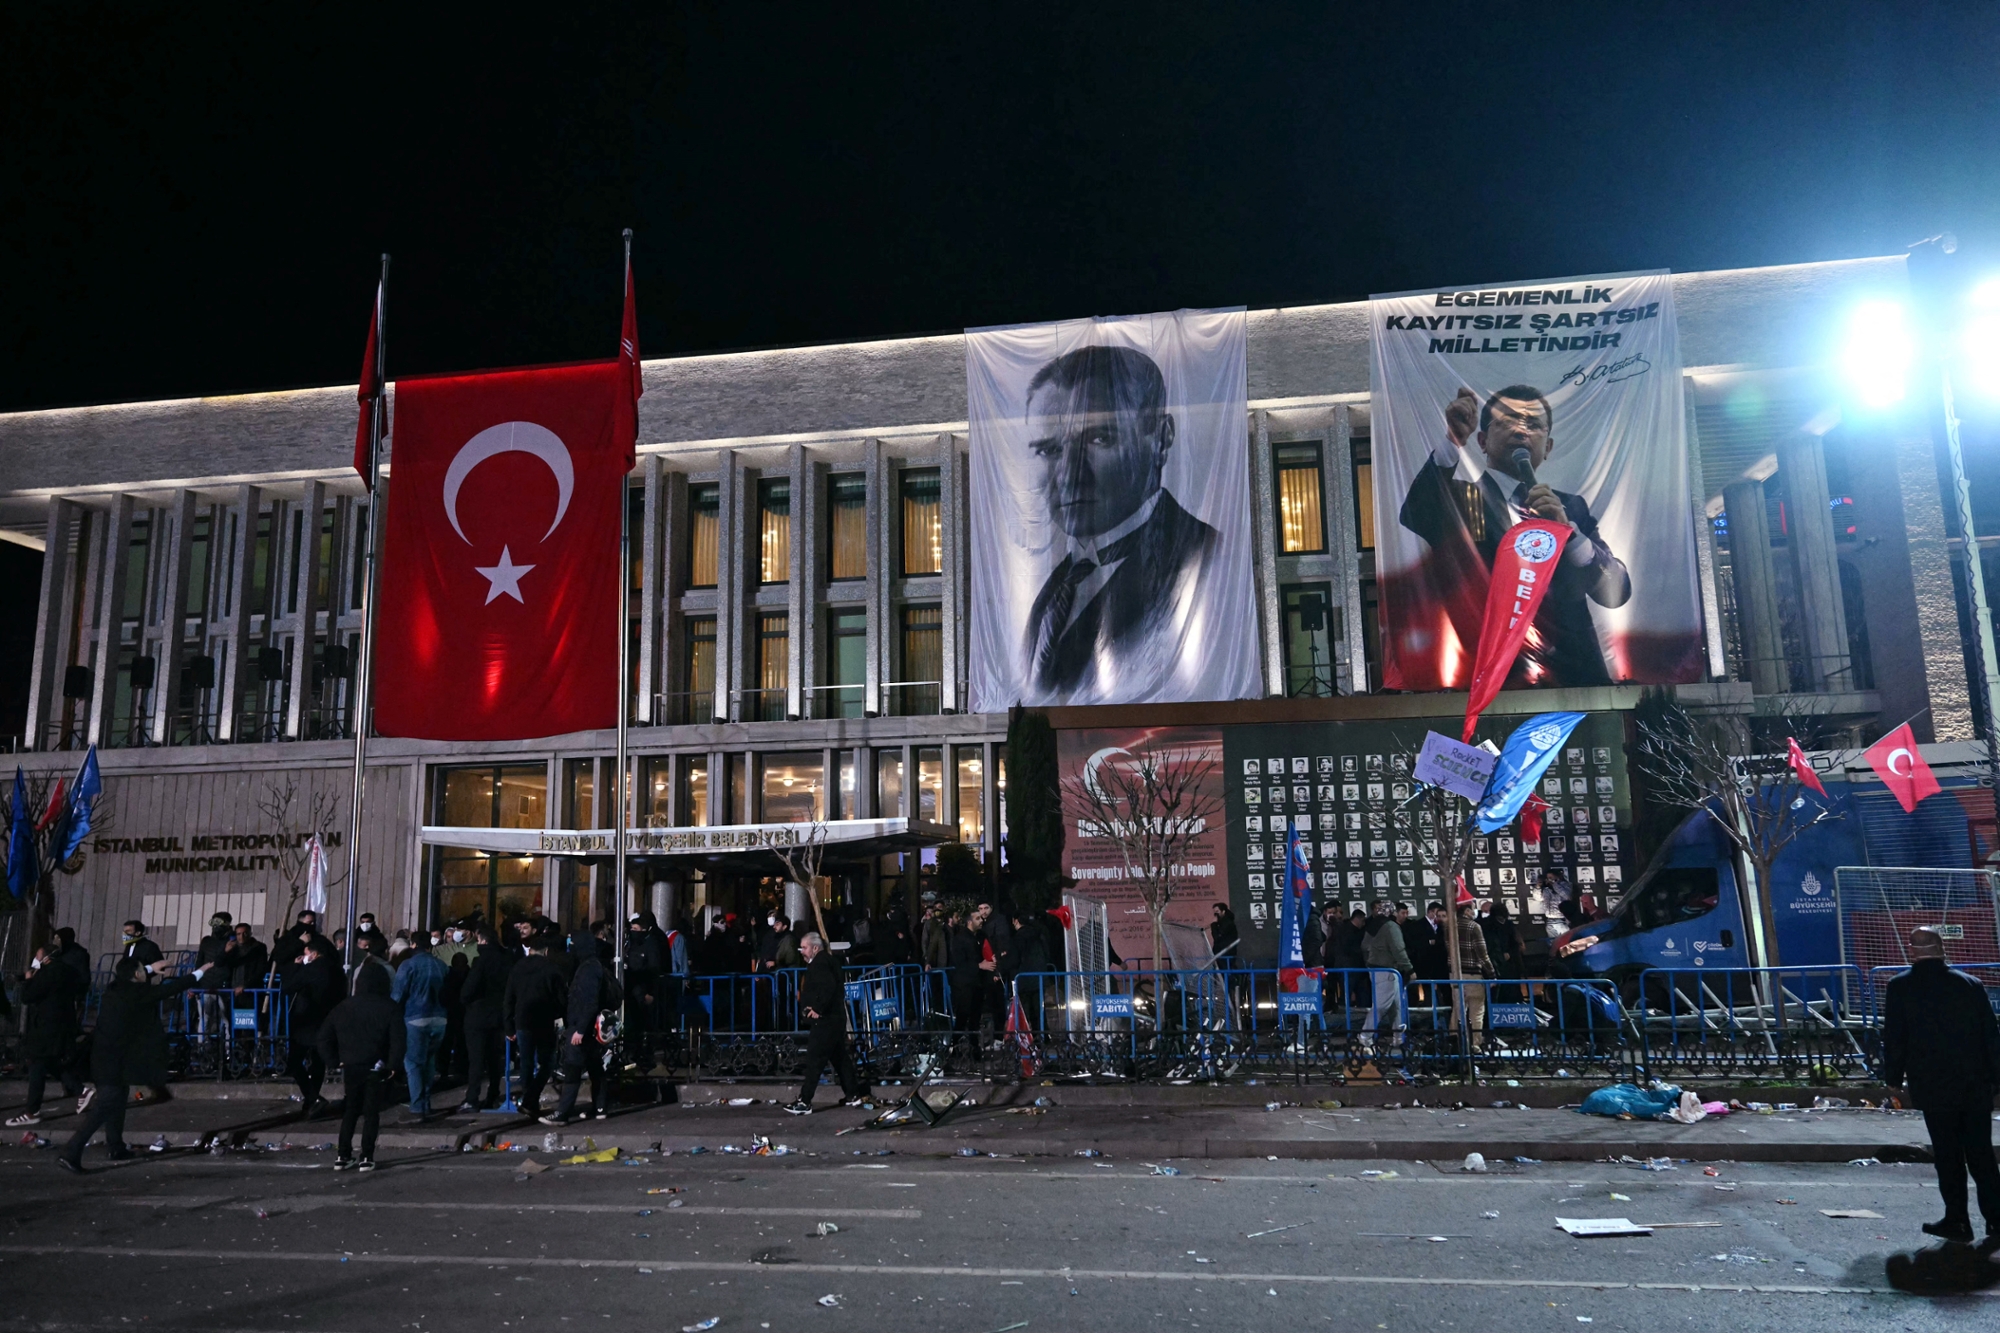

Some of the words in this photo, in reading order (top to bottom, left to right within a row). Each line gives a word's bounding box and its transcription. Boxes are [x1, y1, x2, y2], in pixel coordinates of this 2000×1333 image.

[1435, 285, 1613, 307] EGEMENLİK
[1386, 315, 1524, 330] KAYITSIZ
[1530, 302, 1659, 334] ŞARTSIZ
[1428, 332, 1621, 354] MİLLETİNDİR
[93, 835, 184, 853] İSTANBUL
[538, 831, 609, 850] İSTANBUL
[613, 832, 706, 852] ÜYÜKŞEHİR
[711, 828, 800, 848] BELEDİYESİ
[145, 855, 281, 874] MUNICIPALITY
[1071, 865, 1122, 880] Sovereignty
[1125, 864, 1157, 878] Belos
[1187, 862, 1215, 878] People
[874, 1007, 897, 1017] ZABITA
[1096, 1005, 1128, 1013] ZABITA
[1283, 1003, 1318, 1011] ZABITA
[1493, 1014, 1531, 1024] ZABITA
